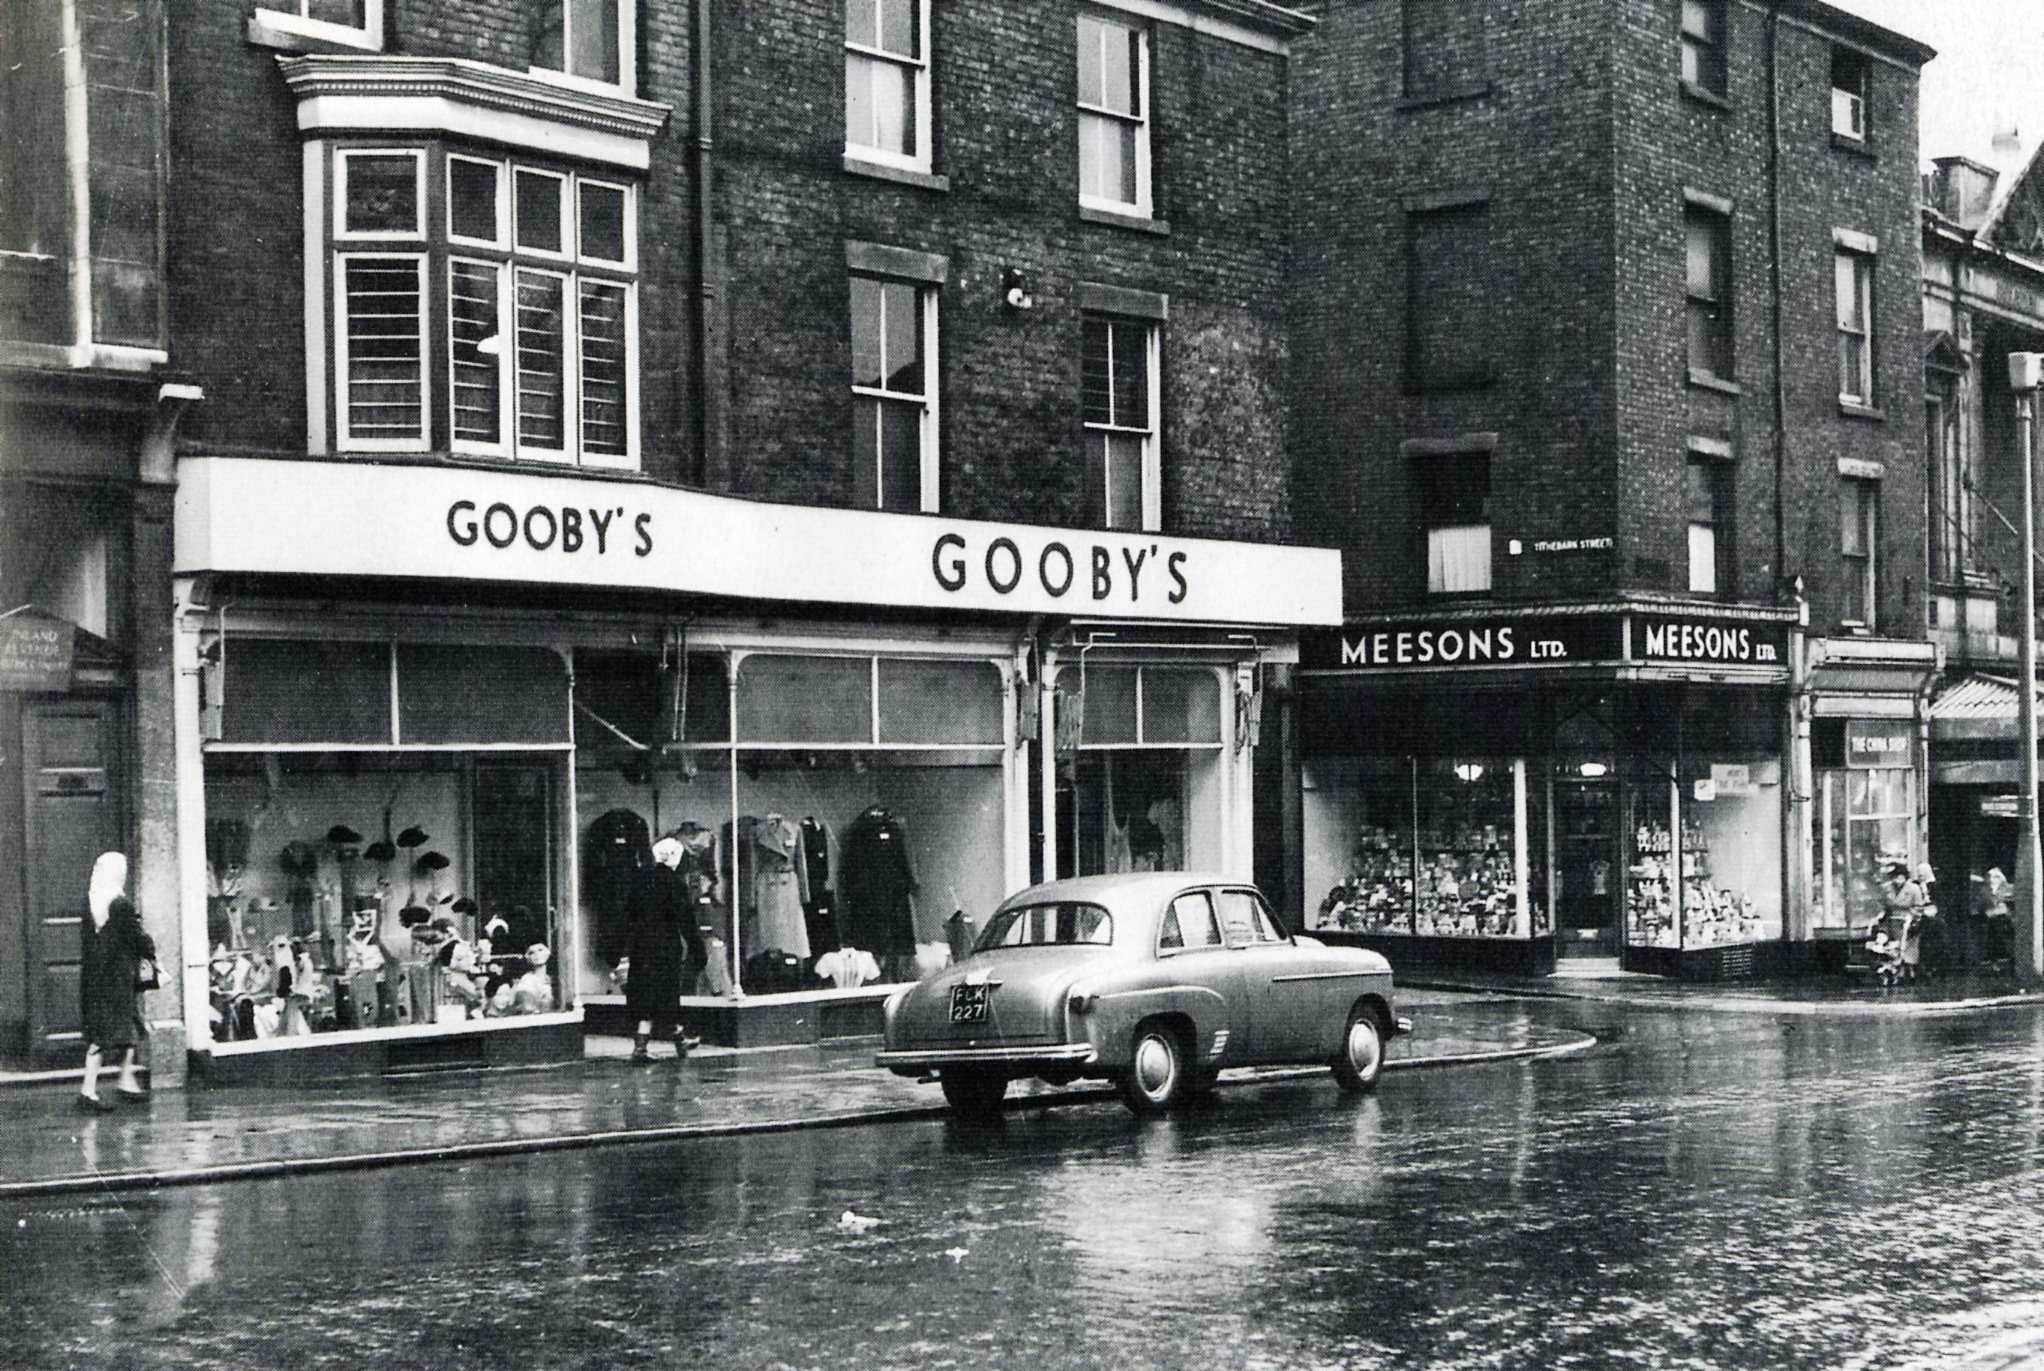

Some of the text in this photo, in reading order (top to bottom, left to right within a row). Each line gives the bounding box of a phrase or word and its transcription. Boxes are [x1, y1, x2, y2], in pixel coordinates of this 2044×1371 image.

[447, 500, 653, 557] GOOBY'S
[1580, 538, 1611, 549] STREET
[932, 533, 1187, 604] GOOBY'S
[1341, 627, 1567, 664] MEESONS LTD.
[1646, 624, 1749, 660] MEESONS
[954, 1004, 983, 1020] 227
